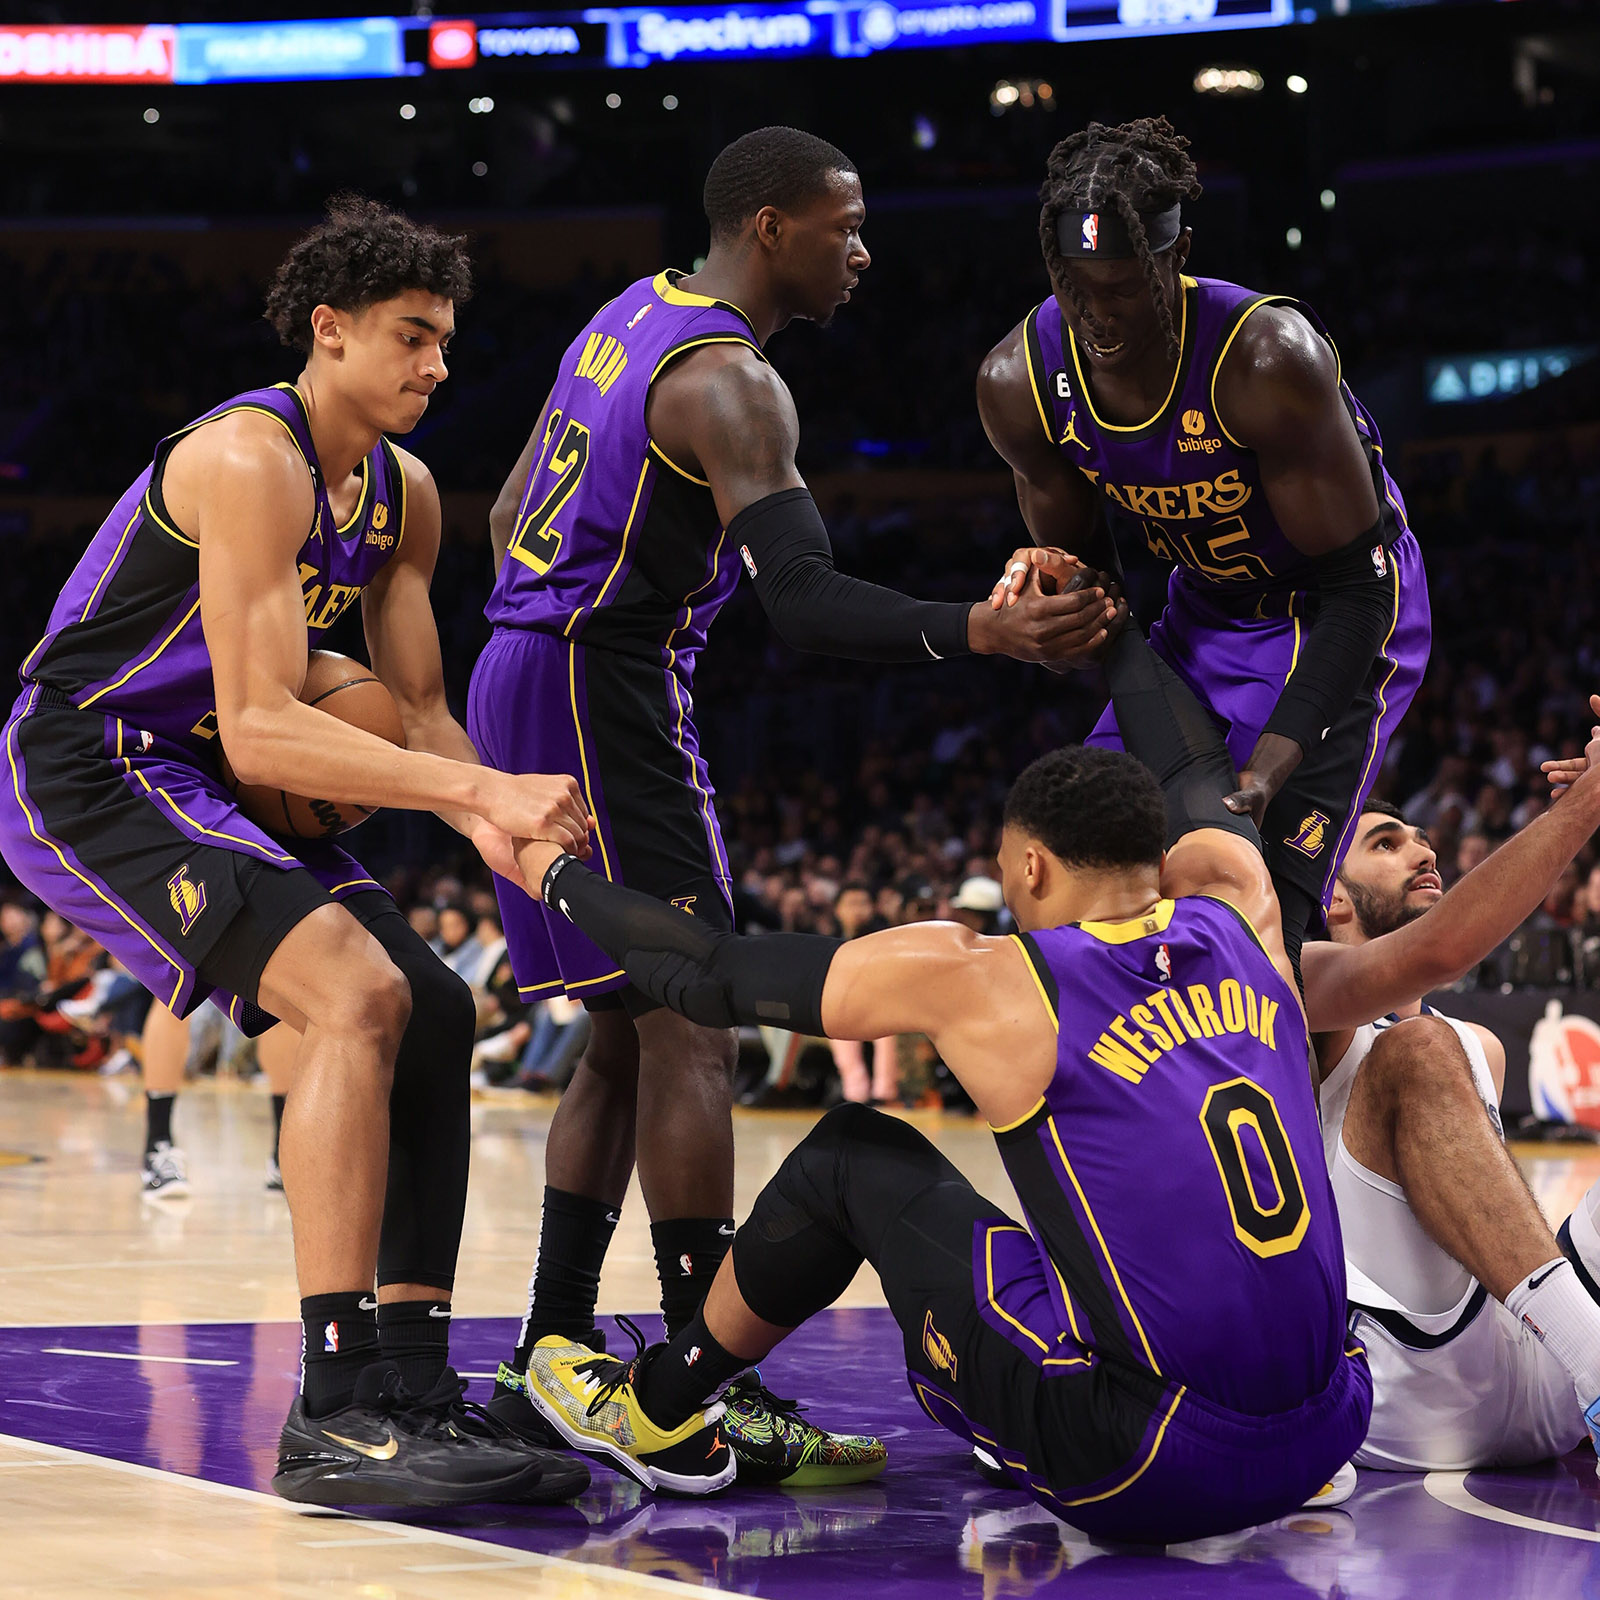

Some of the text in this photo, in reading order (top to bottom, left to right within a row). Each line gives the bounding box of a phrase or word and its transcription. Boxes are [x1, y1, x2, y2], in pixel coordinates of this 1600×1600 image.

[637, 11, 811, 61] Spectrum
[1056, 372, 1072, 398] 6
[1177, 436, 1223, 454] bibigo
[1079, 466, 1253, 520] AKERS
[365, 529, 394, 551] bibigo
[1087, 978, 1279, 1085] WESTBROOK
[1198, 1076, 1312, 1260] 0
